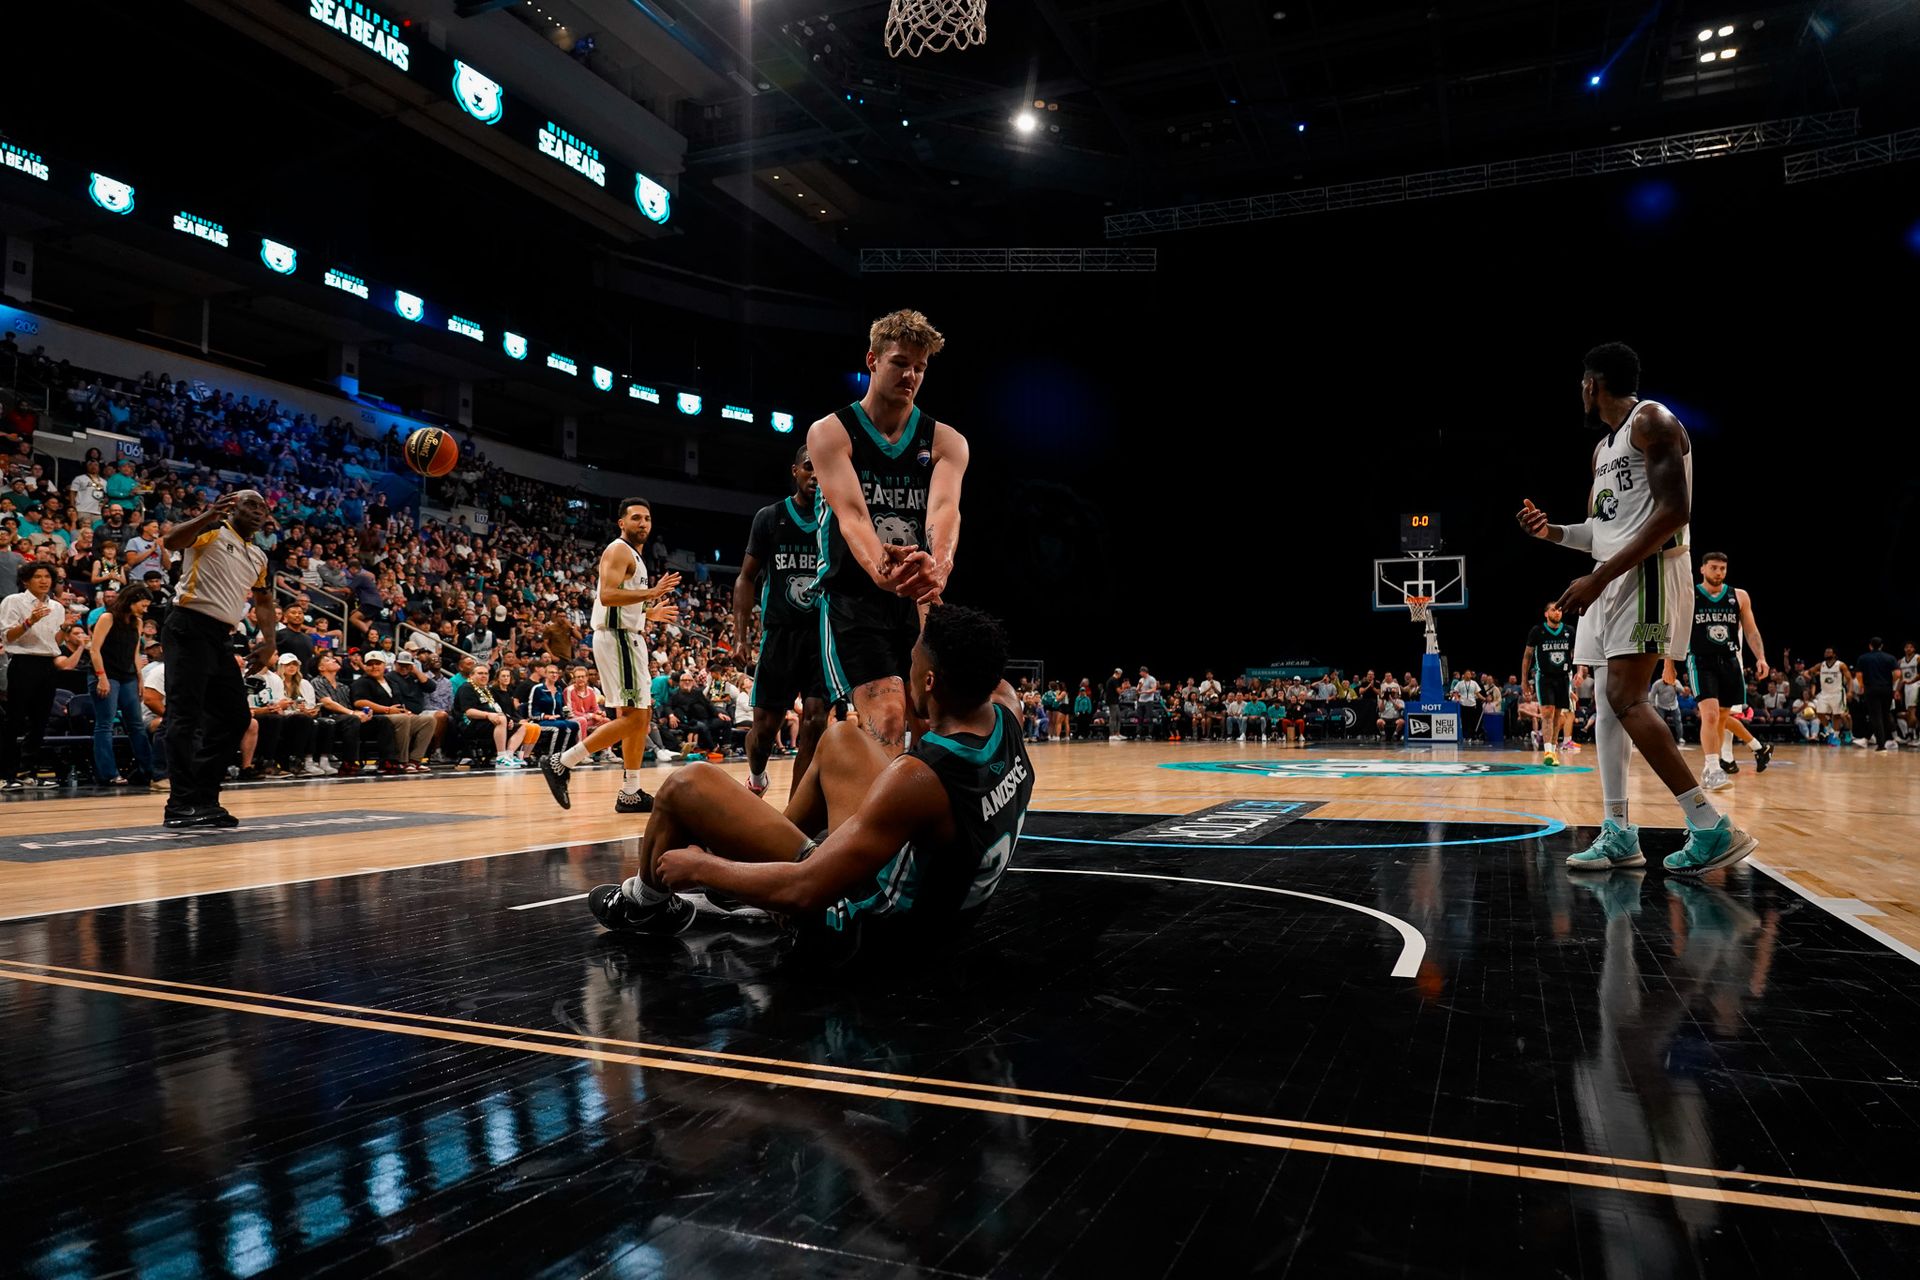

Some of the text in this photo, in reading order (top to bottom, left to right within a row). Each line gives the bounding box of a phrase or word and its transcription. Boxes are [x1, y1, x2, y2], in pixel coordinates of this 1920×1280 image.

[310, 0, 410, 71] SEA BEARS
[547, 121, 599, 160] WINNIPEG
[6, 151, 49, 181] BEARS
[538, 128, 606, 187] SEA BEARS
[173, 215, 229, 247] SEA BEARS
[118, 441, 141, 457] 106
[1615, 469, 1634, 492] 13
[775, 553, 797, 571] SEA
[1695, 612, 1737, 625] SEA BEARS
[1435, 719, 1454, 727] NEW
[1435, 727, 1454, 735] ERA
